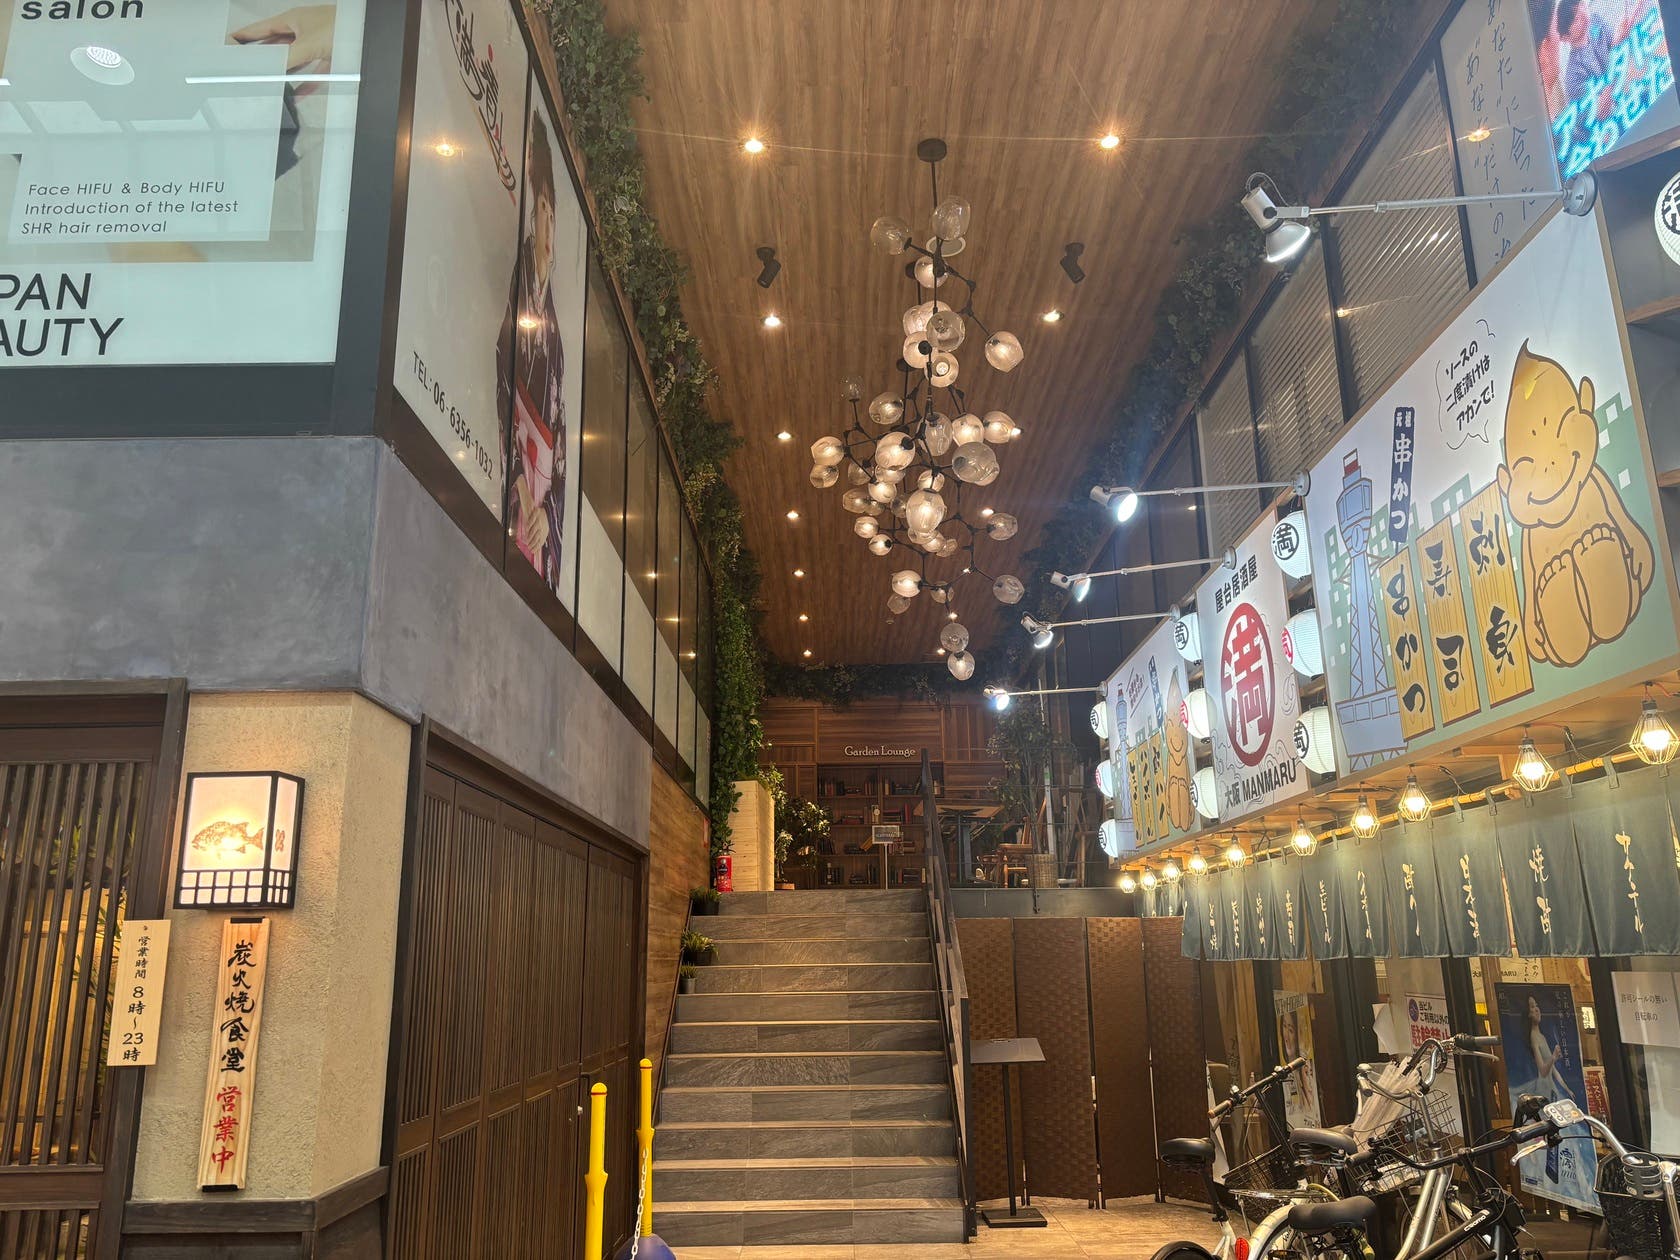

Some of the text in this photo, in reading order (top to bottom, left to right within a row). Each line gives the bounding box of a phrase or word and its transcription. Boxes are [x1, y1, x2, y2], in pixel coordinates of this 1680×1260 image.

[21, 0, 144, 20] salon
[25, 200, 239, 215] Introduction of the latest
[28, 181, 225, 196] Face HIFU & Body HIFU
[21, 221, 167, 234] SHR hair removal
[1445, 340, 1478, 380] ソースの
[1445, 354, 1490, 412] 二度漬けは
[433, 382, 493, 480] 06-6356-1032
[1391, 433, 1412, 530] 串かつ
[1214, 554, 1259, 613] 屋台居酒屋
[1469, 511, 1518, 674] 刺身
[1386, 564, 1425, 713] 串かつ
[1425, 540, 1464, 691] 寿司
[1221, 607, 1272, 756] 満
[844, 745, 916, 758] Garden Lounge
[1224, 775, 1240, 809] 大阪
[1242, 757, 1297, 800] MANMARU
[135, 935, 151, 979] 営業時間
[211, 939, 257, 1175] 炭火焼食堂 営業中
